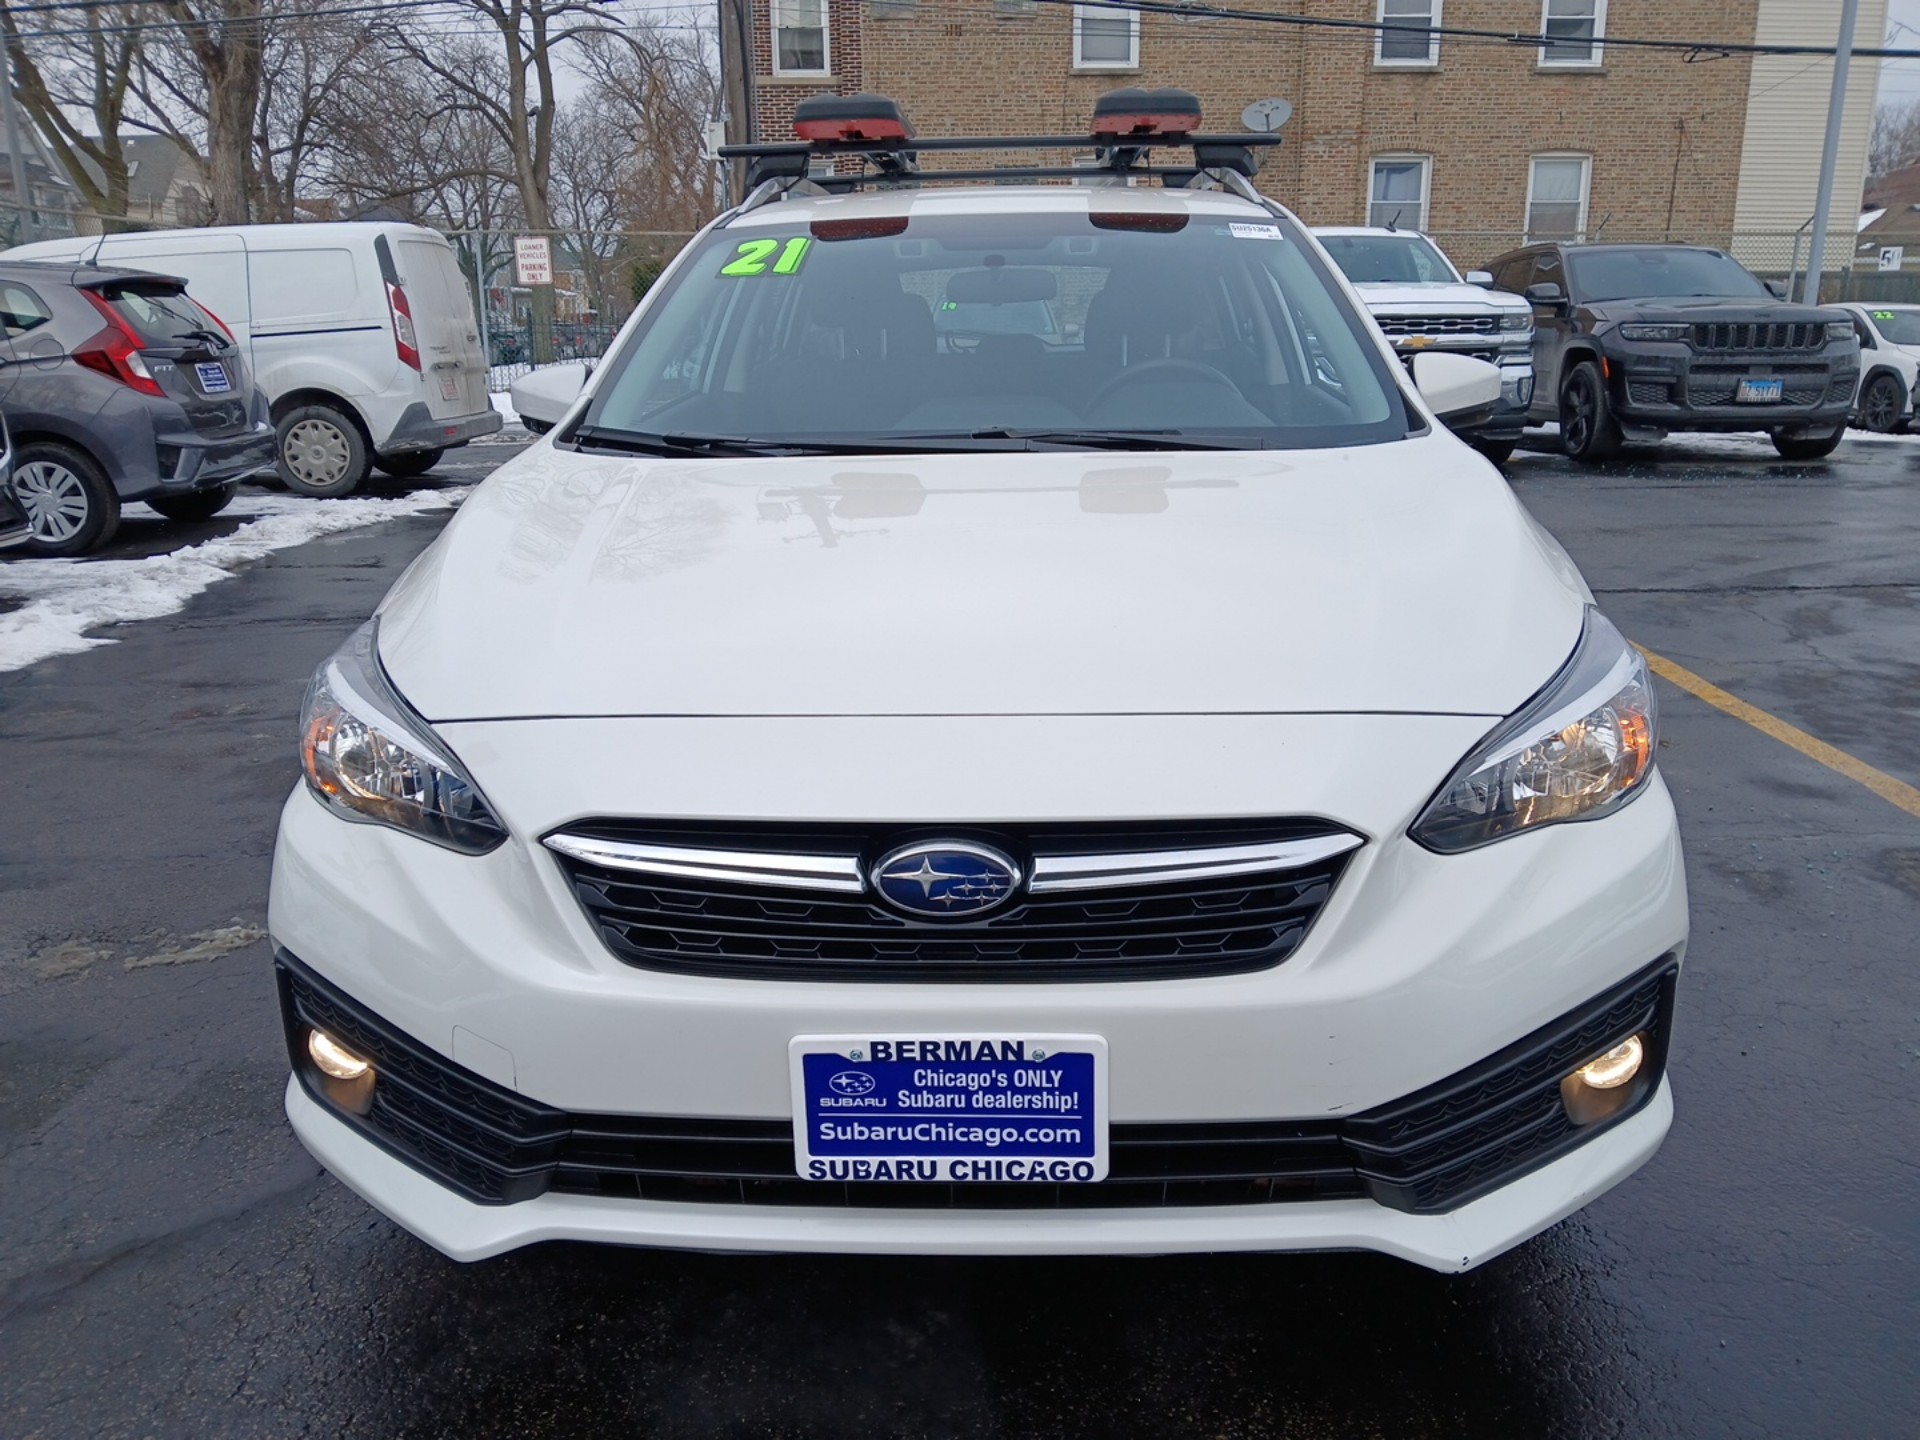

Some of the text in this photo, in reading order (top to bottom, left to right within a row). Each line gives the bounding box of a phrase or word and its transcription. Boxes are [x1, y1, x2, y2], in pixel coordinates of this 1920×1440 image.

[721, 237, 811, 275] 21
[521, 263, 547, 271] PARKING
[527, 272, 543, 281] ONLY
[1873, 311, 1895, 320] 22
[154, 364, 174, 373] FIT
[869, 1040, 1025, 1062] BERMAN
[913, 1069, 1063, 1090] Chicago's ONLY
[819, 1097, 887, 1107] SUBARU
[897, 1090, 1079, 1113] Subaru dealership!
[819, 1122, 1082, 1146] SubaruChicago.com
[808, 1159, 1095, 1182] SUBARU CHICAGO
